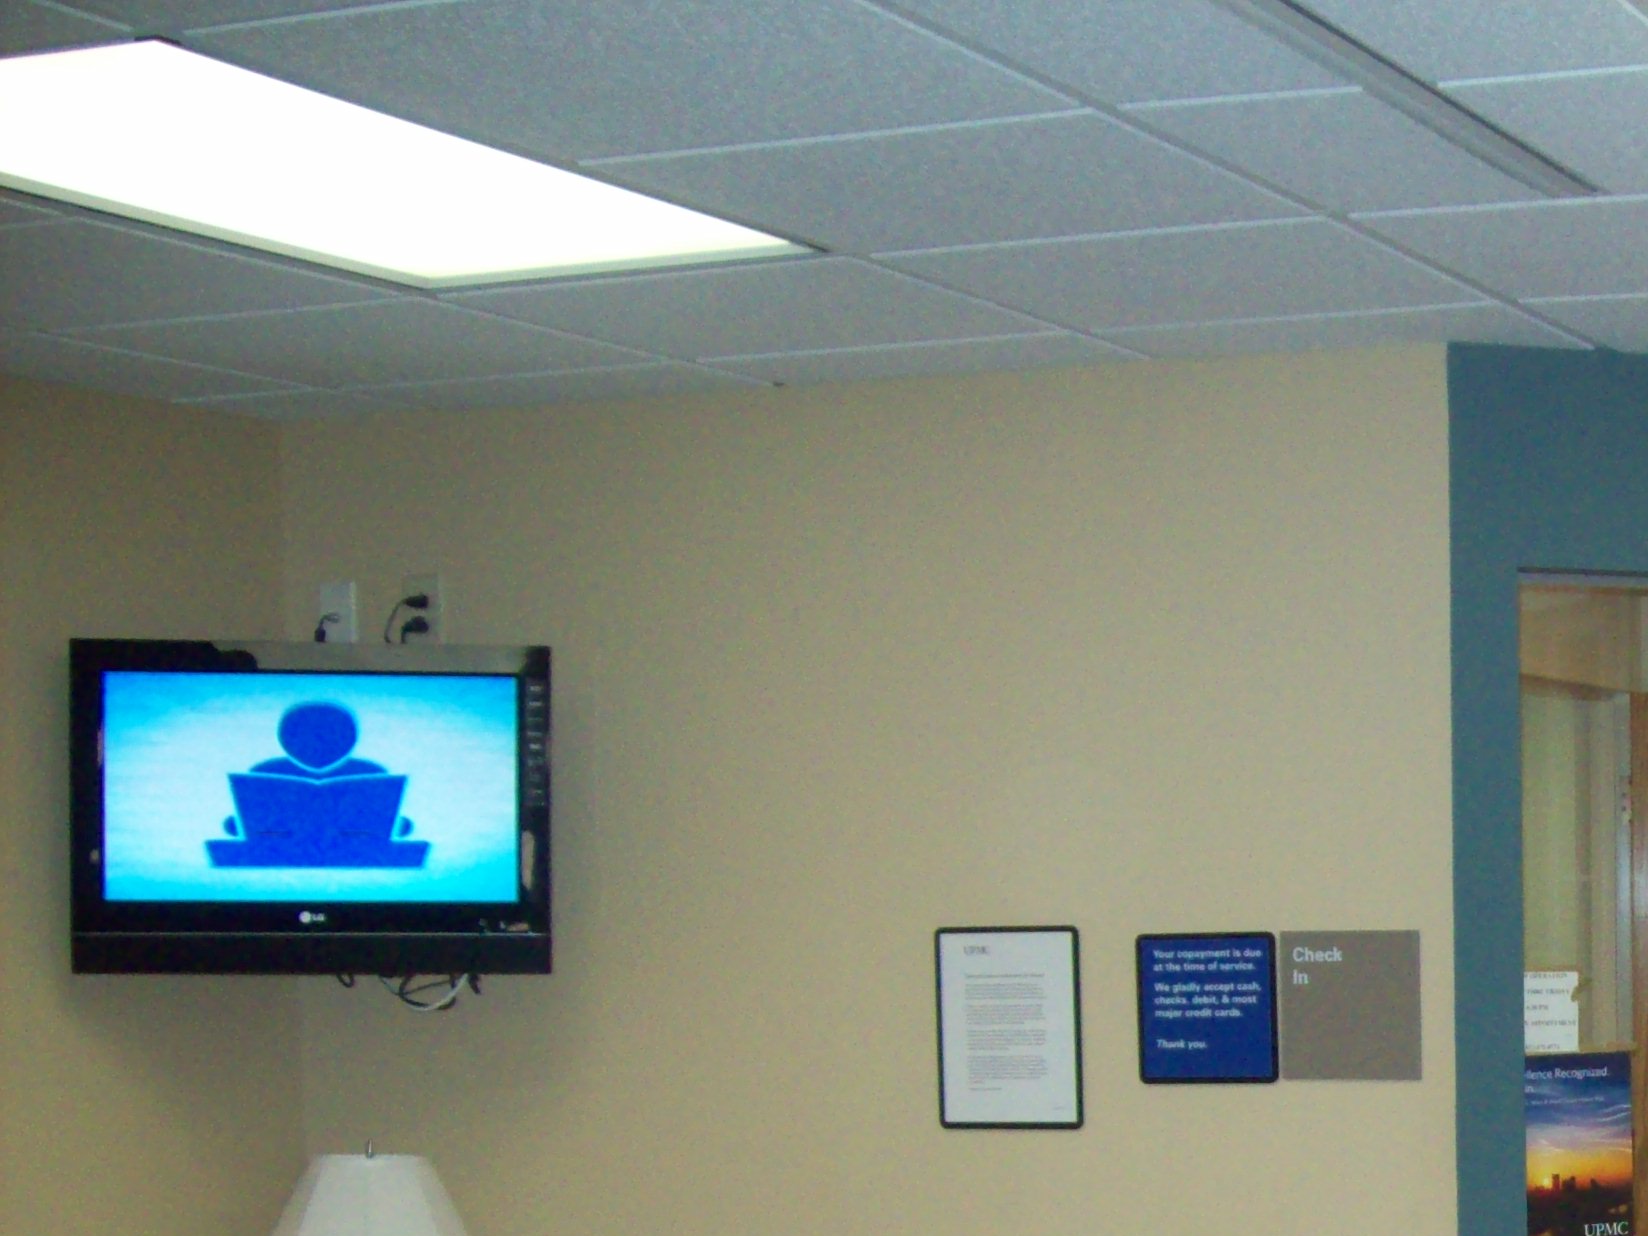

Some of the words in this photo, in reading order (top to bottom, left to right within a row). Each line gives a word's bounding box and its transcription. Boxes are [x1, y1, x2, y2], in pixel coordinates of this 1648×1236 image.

[1153, 949, 1174, 959] Your
[1177, 949, 1230, 960] copayment
[1232, 948, 1241, 958] is
[1243, 948, 1262, 958] due
[1292, 946, 1343, 963] Check
[1153, 963, 1163, 972] at
[1165, 962, 1181, 972] the
[1183, 962, 1205, 972] time
[1208, 961, 1218, 971] of
[1292, 969, 1309, 985] In
[1154, 982, 1169, 992] We
[1172, 982, 1200, 993] gladly
[1204, 982, 1234, 993] accept
[1237, 982, 1262, 992] cash,
[1191, 995, 1219, 1005] debit,
[1221, 995, 1229, 1004] &
[1232, 995, 1257, 1004] most
[1155, 1008, 1182, 1019] major
[1185, 1007, 1212, 1017] credit
[1214, 1008, 1243, 1018] cards.
[1157, 1039, 1185, 1049] Thank
